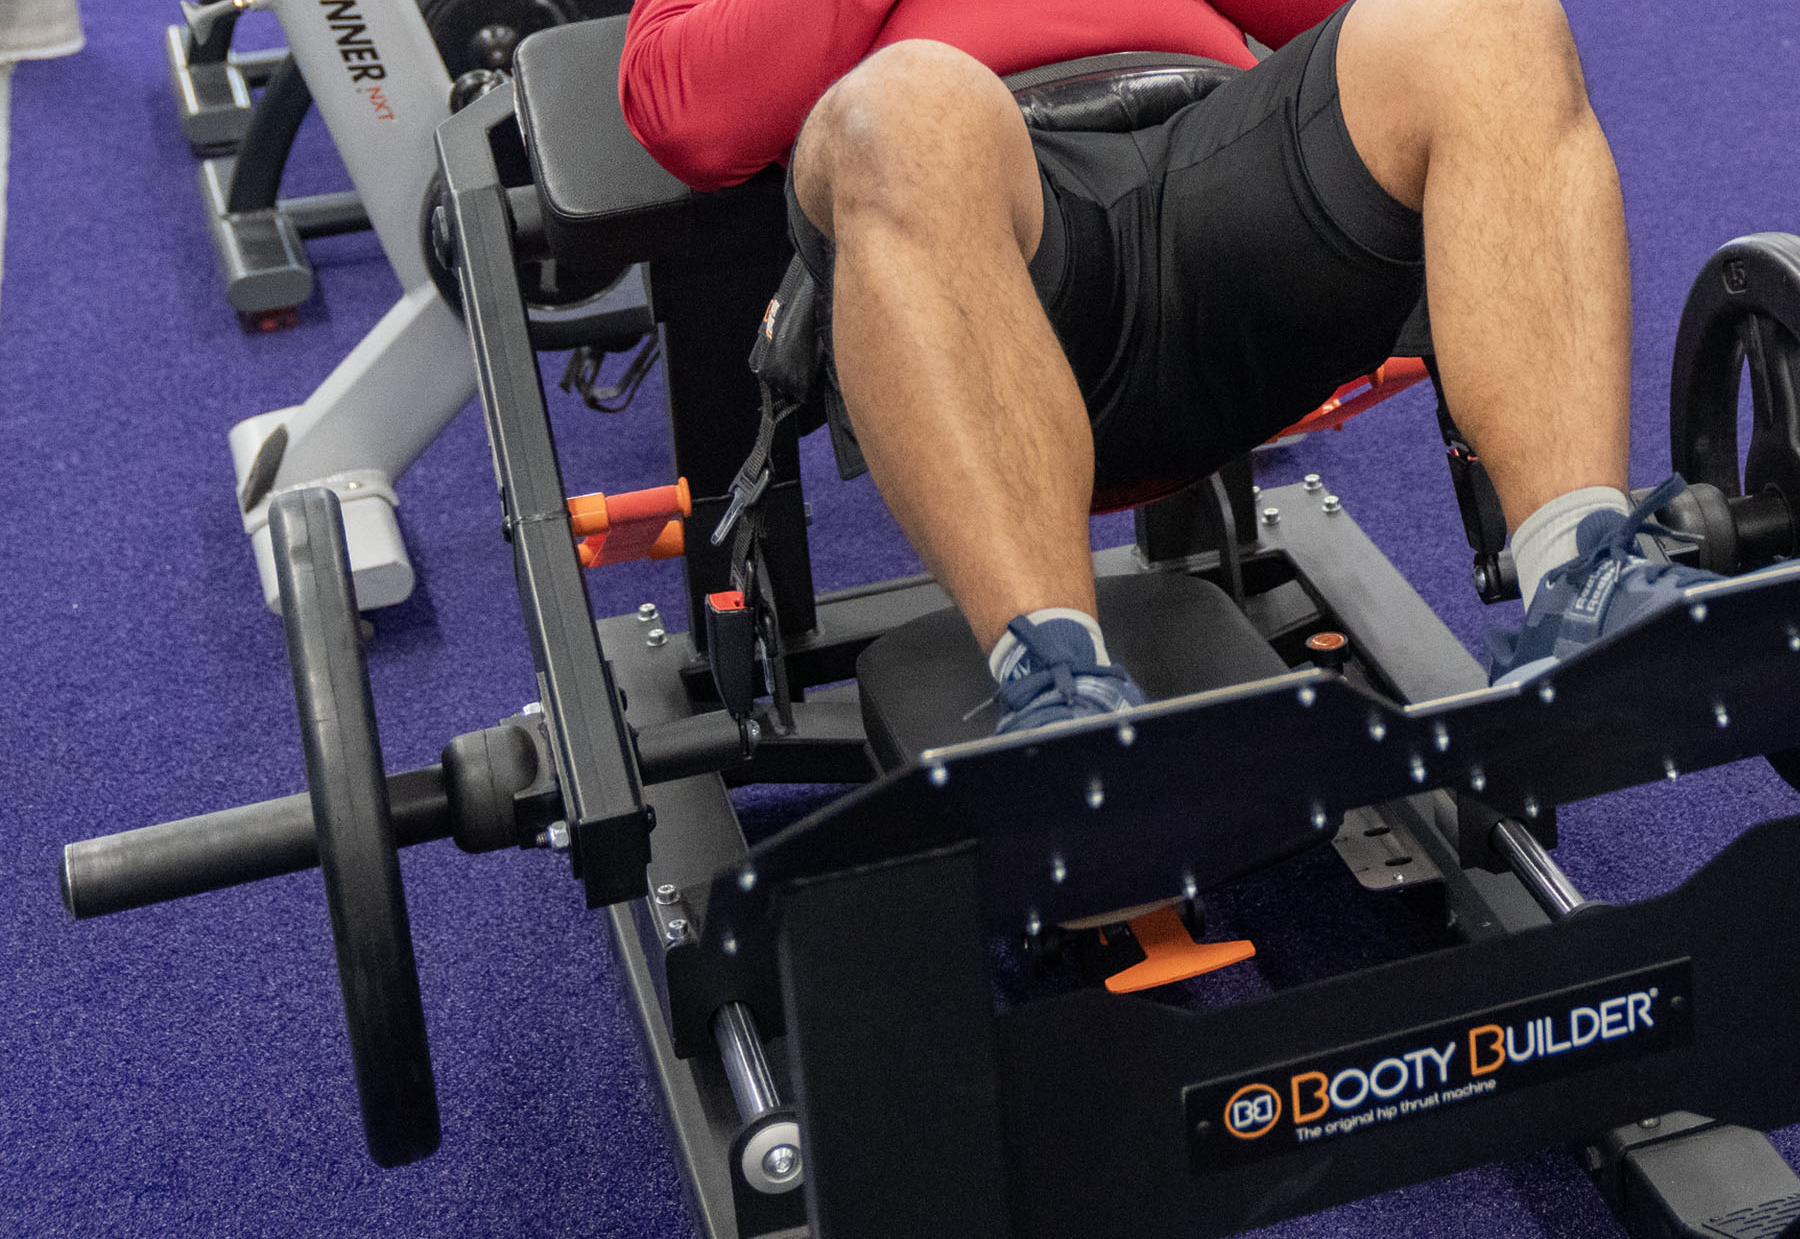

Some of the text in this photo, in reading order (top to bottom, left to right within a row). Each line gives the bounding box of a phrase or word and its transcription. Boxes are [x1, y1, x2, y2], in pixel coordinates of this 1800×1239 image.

[366, 86, 395, 121] NXT
[1291, 990, 1656, 1125] BOOTY BUILDER
[1296, 1079, 1496, 1142] The original hip thrust machine
